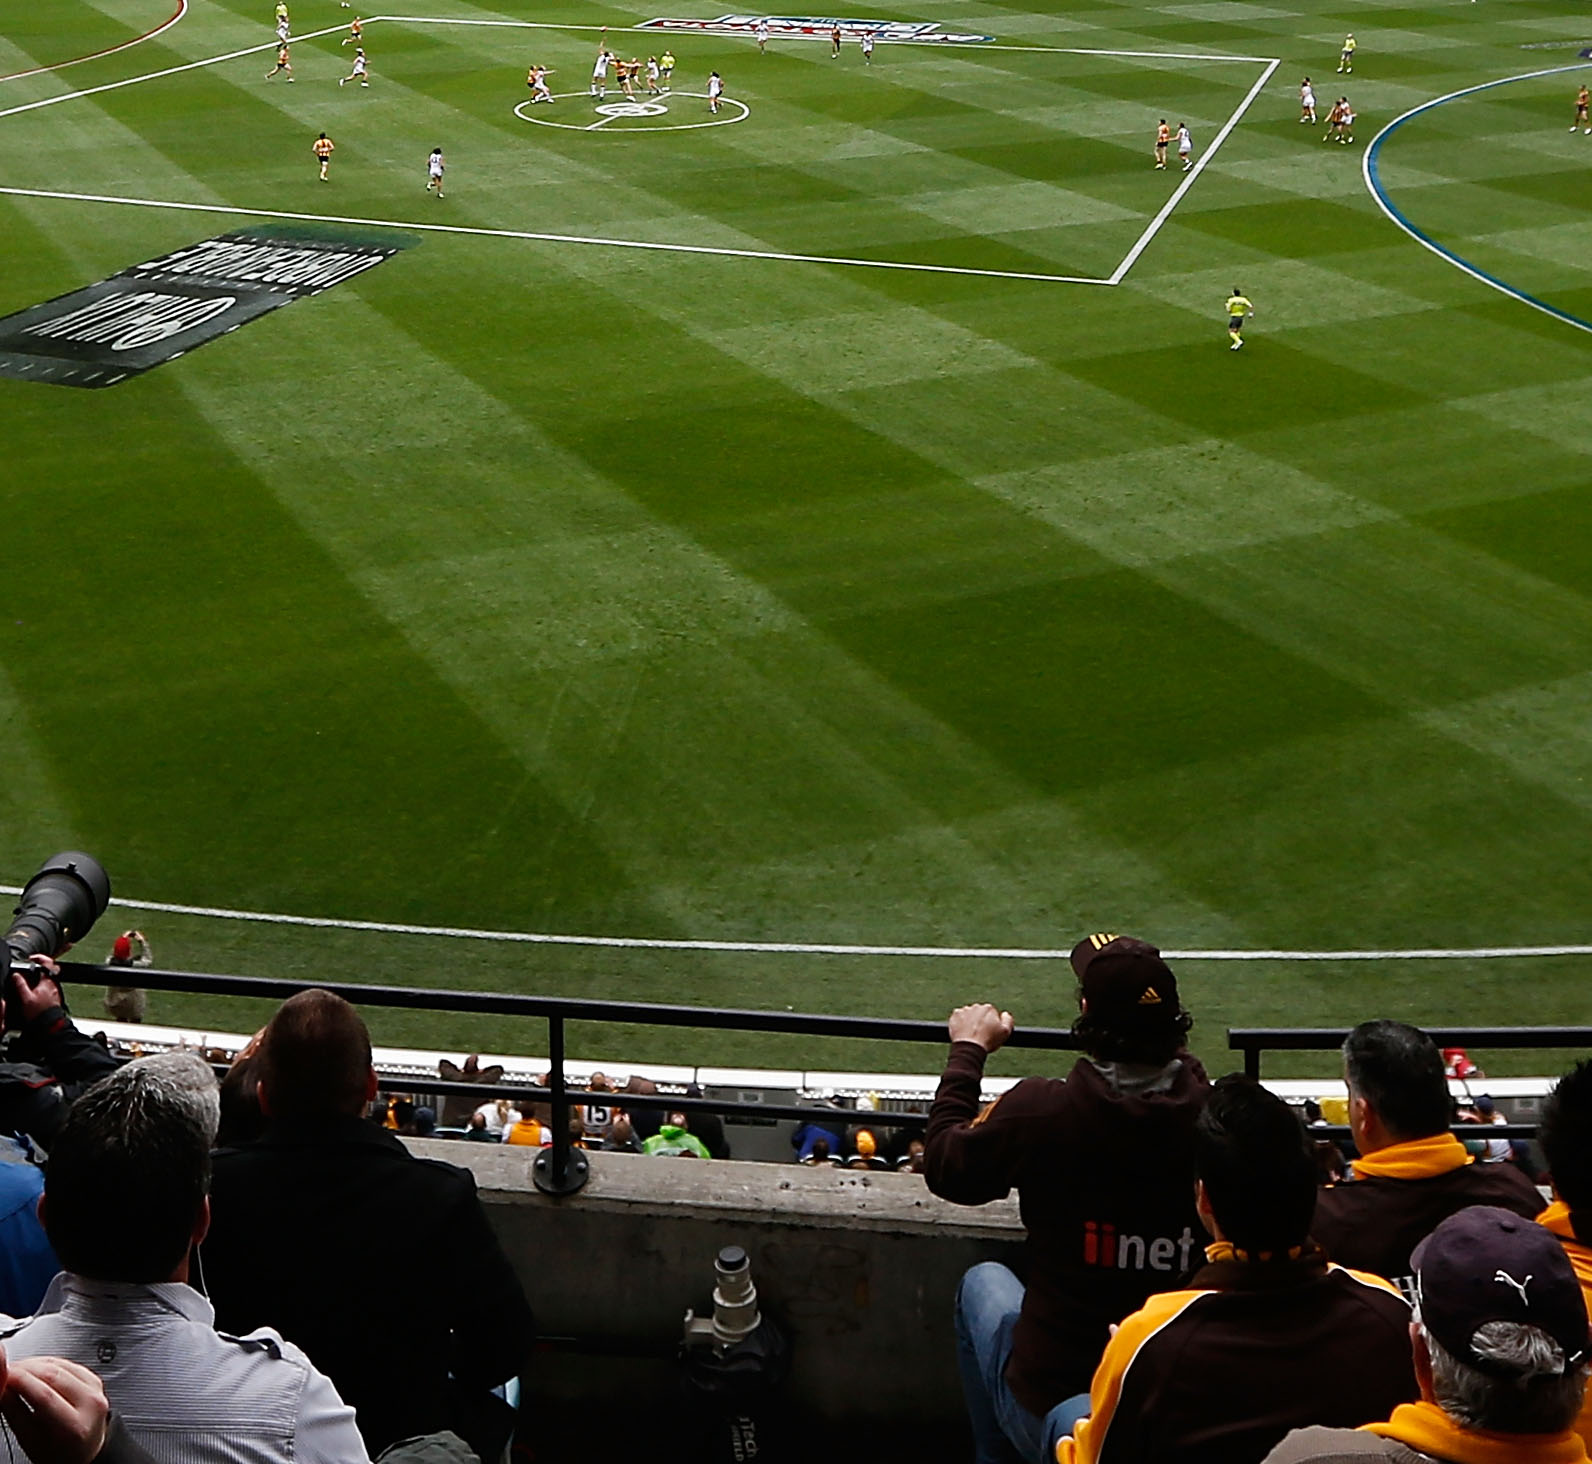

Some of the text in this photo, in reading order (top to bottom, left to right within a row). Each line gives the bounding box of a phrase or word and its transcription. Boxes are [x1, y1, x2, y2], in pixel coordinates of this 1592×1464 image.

[136, 241, 385, 288] UNBREAKABLE
[20, 290, 191, 343] HILUX
[1084, 1221, 1195, 1273] iinet
